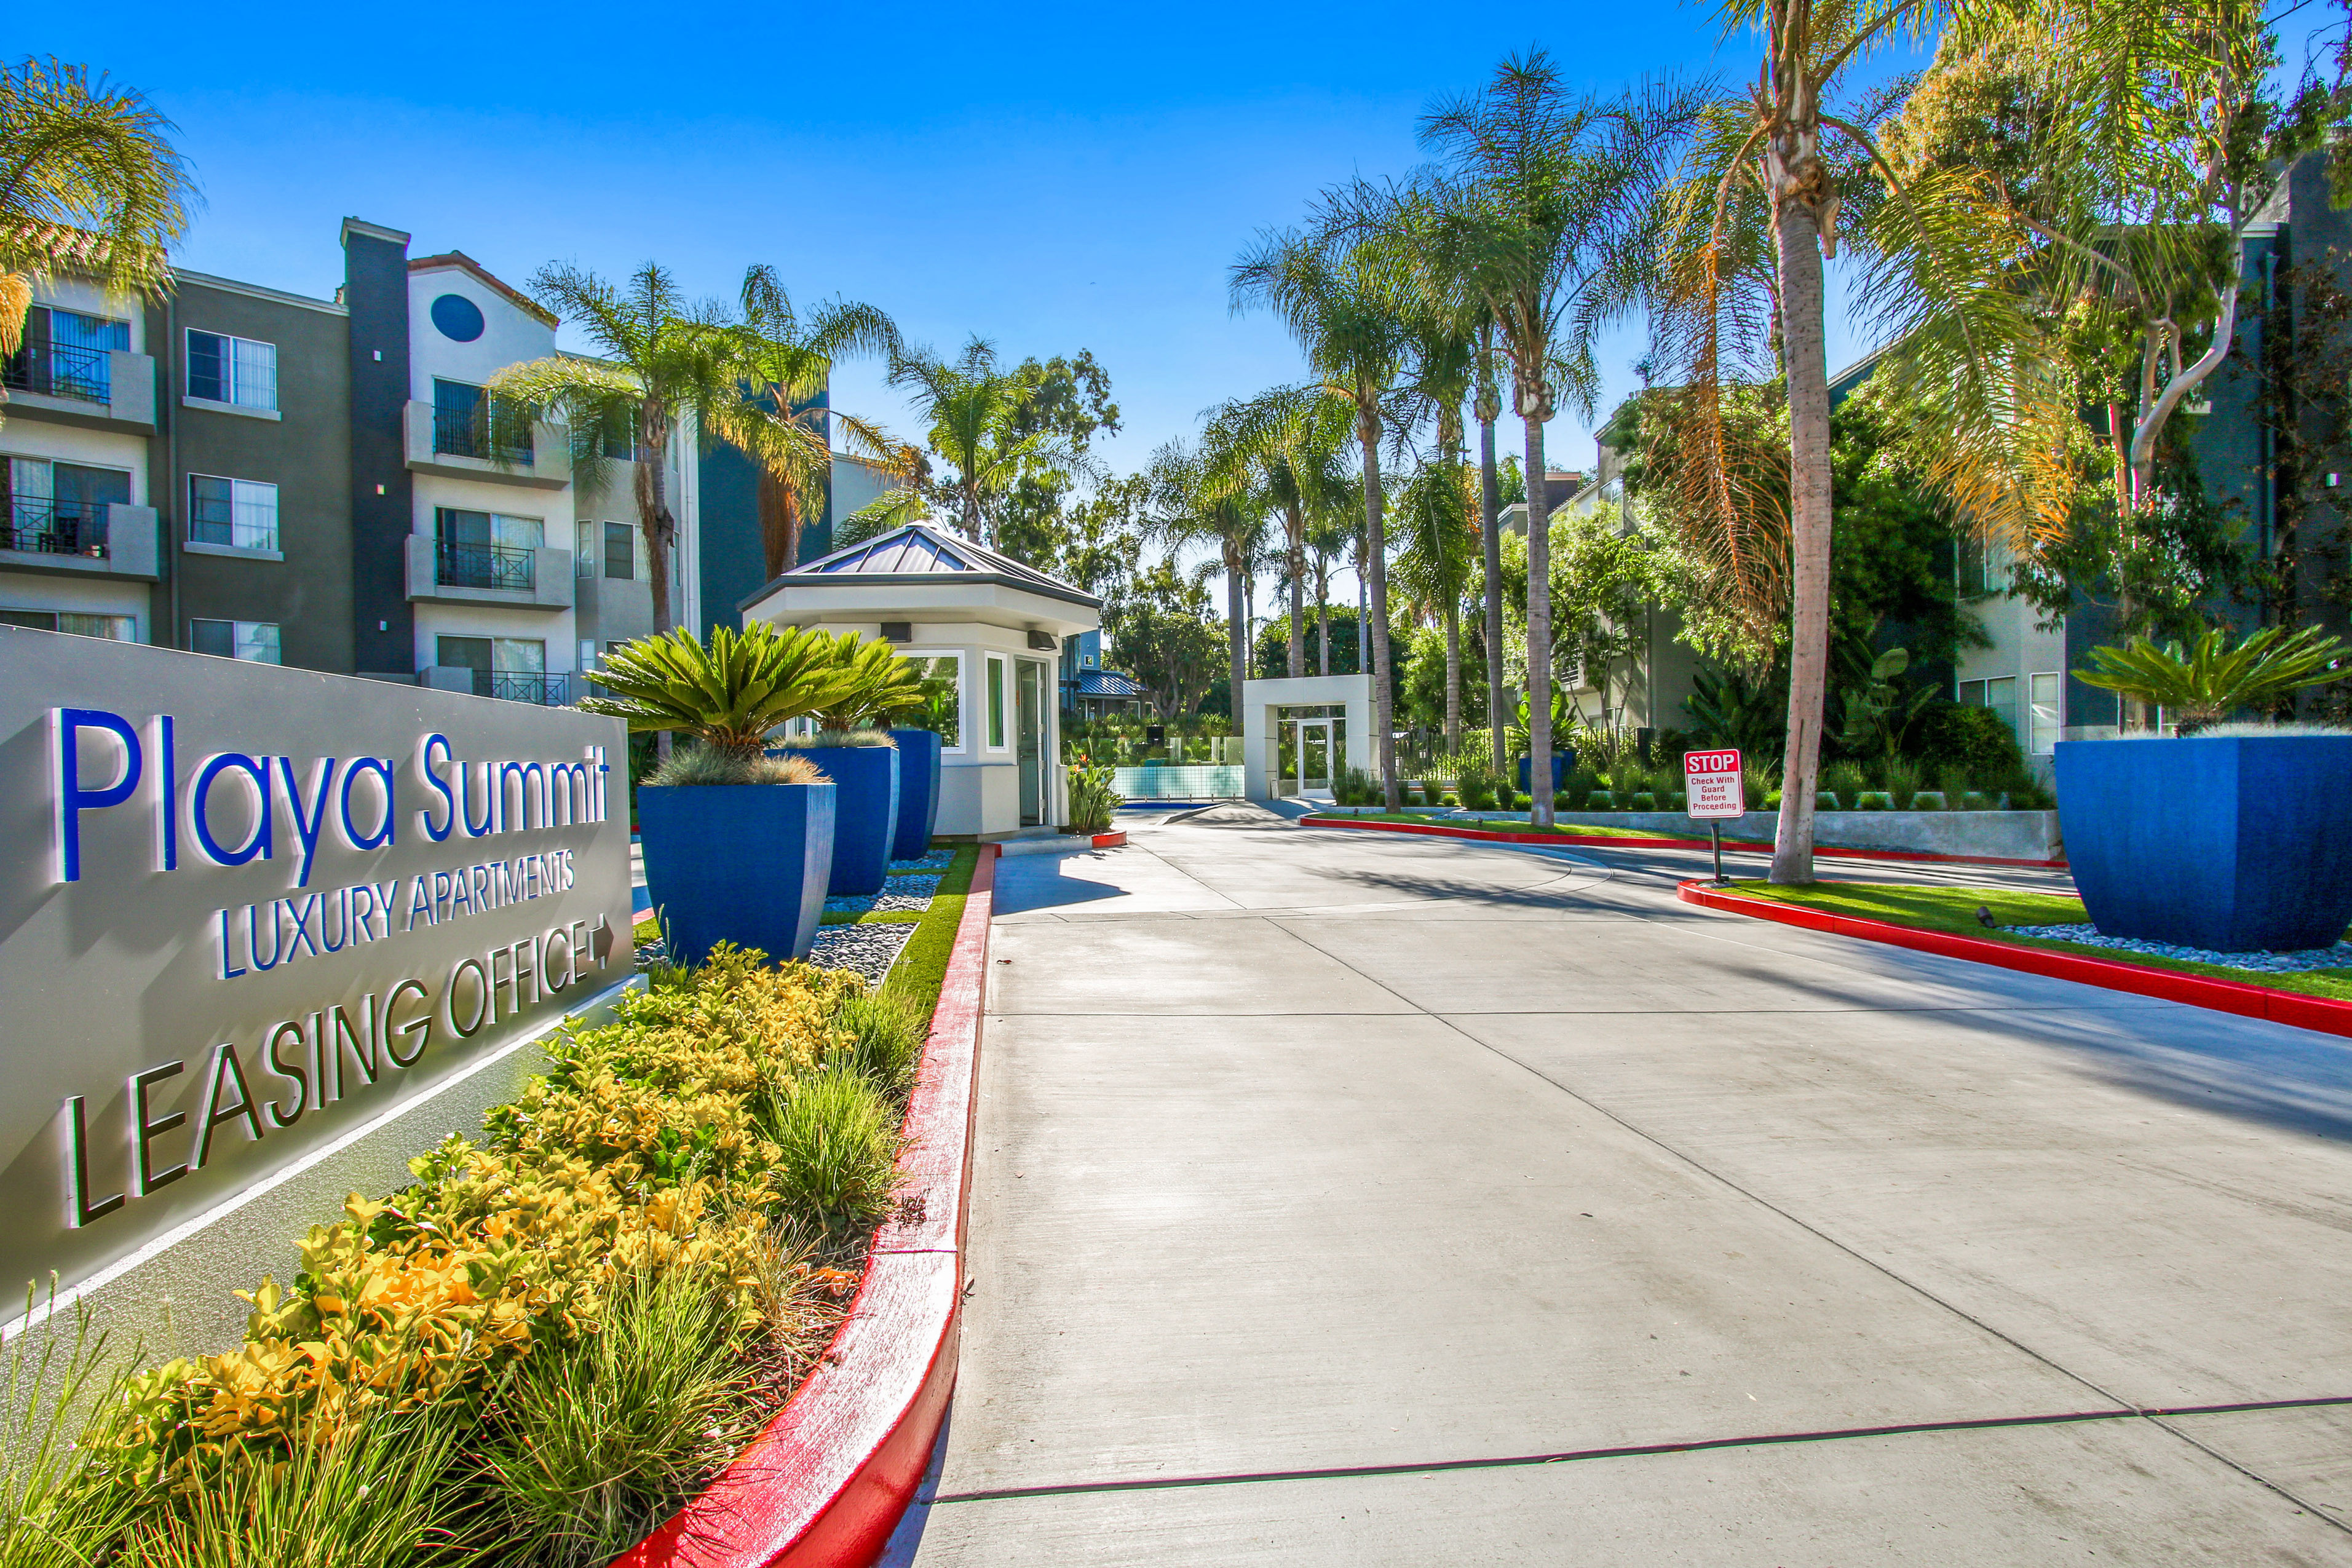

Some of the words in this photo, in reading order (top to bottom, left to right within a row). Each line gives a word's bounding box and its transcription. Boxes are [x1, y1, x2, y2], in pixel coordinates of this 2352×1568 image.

[53, 708, 395, 887] Playa
[416, 732, 610, 843] Summit
[1689, 754, 1735, 772] STOP
[217, 879, 398, 980] LUXURY
[404, 849, 575, 932] APARTMENTS
[65, 978, 433, 1228] LEASING
[447, 920, 588, 1039] OFFICE
